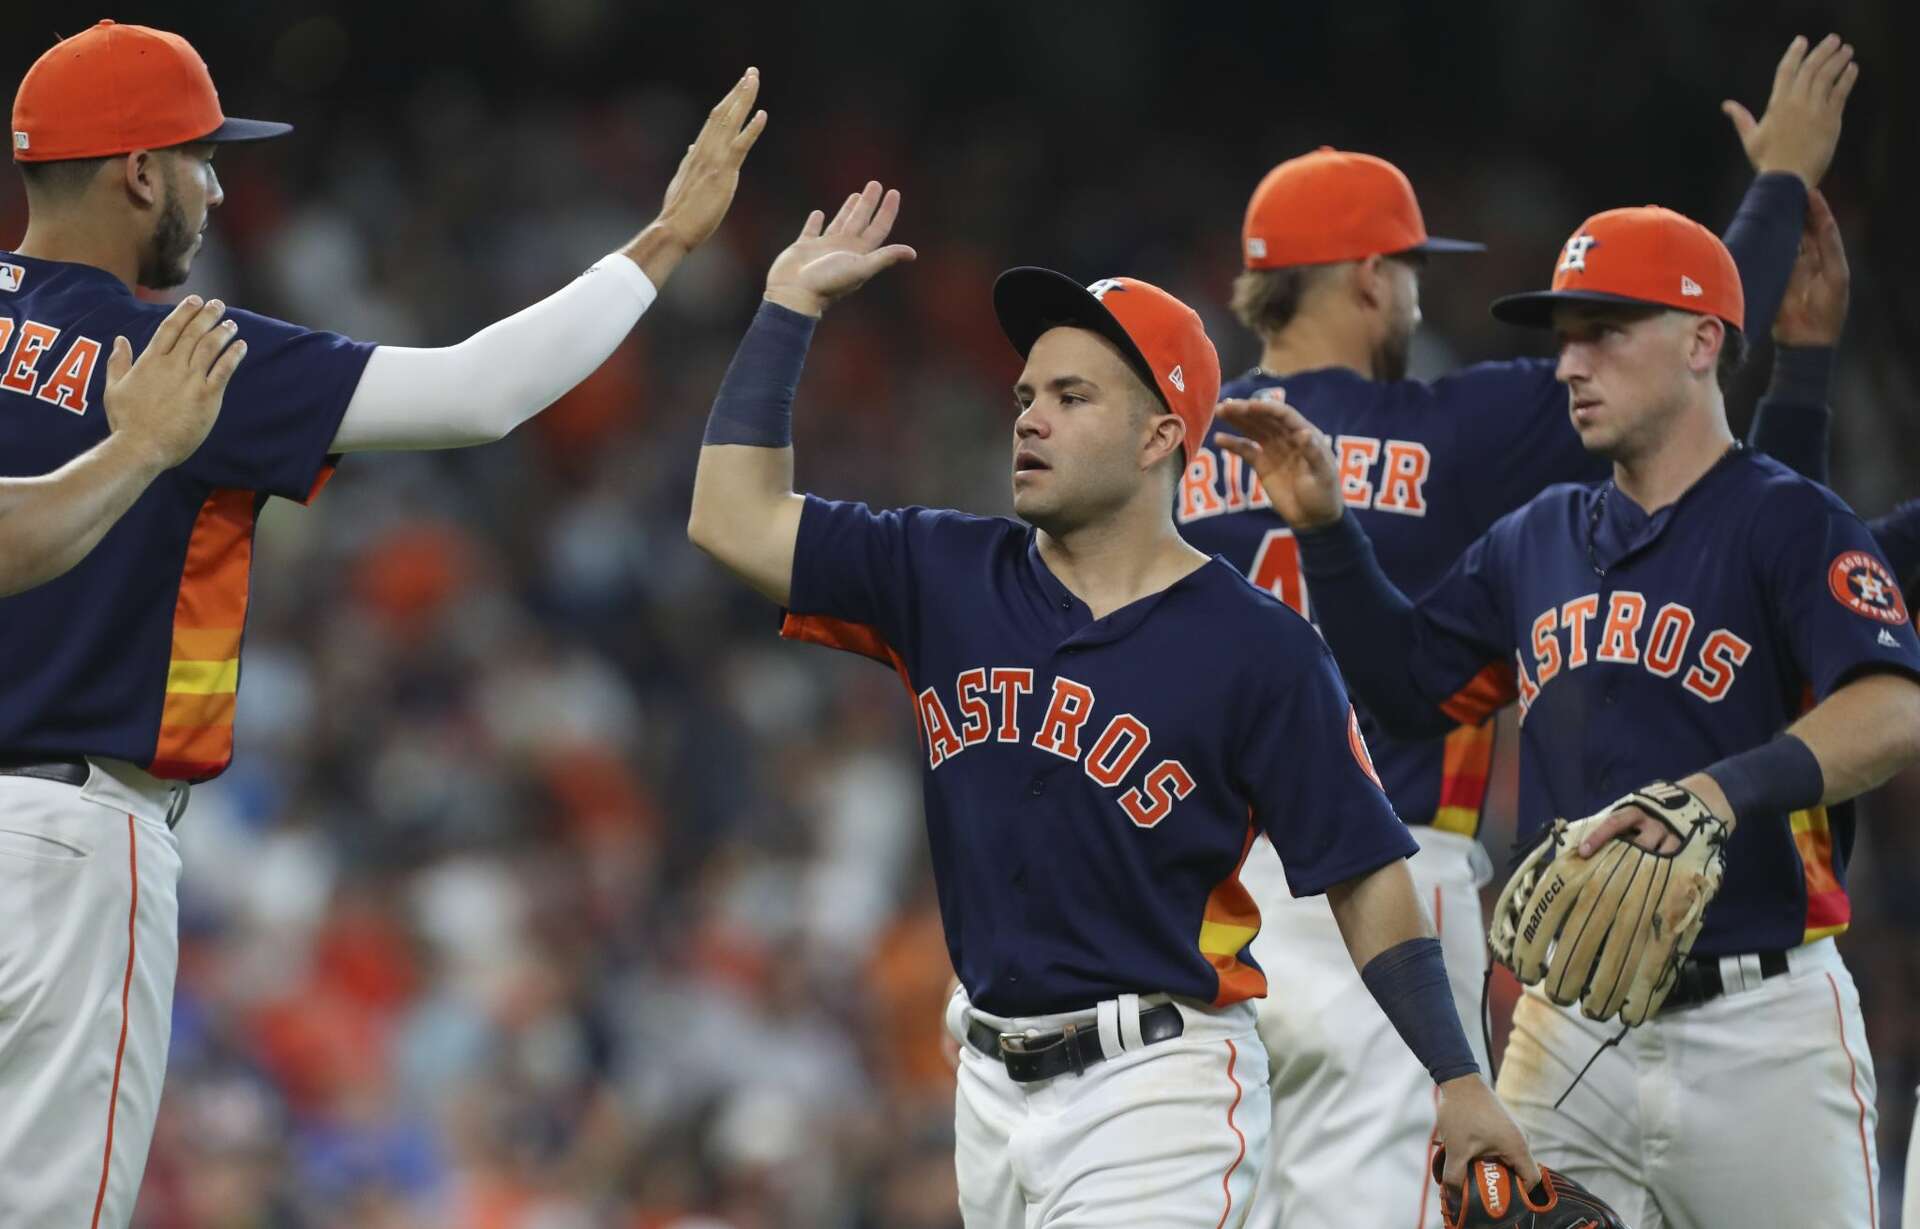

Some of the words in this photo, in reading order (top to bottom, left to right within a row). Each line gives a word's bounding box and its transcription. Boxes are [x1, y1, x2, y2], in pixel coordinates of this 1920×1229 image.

[1178, 435, 1431, 524] RIER
[918, 666, 1198, 828] ASTROS
[1523, 873, 1565, 945] marucci
[1481, 1161, 1501, 1210] ilson
